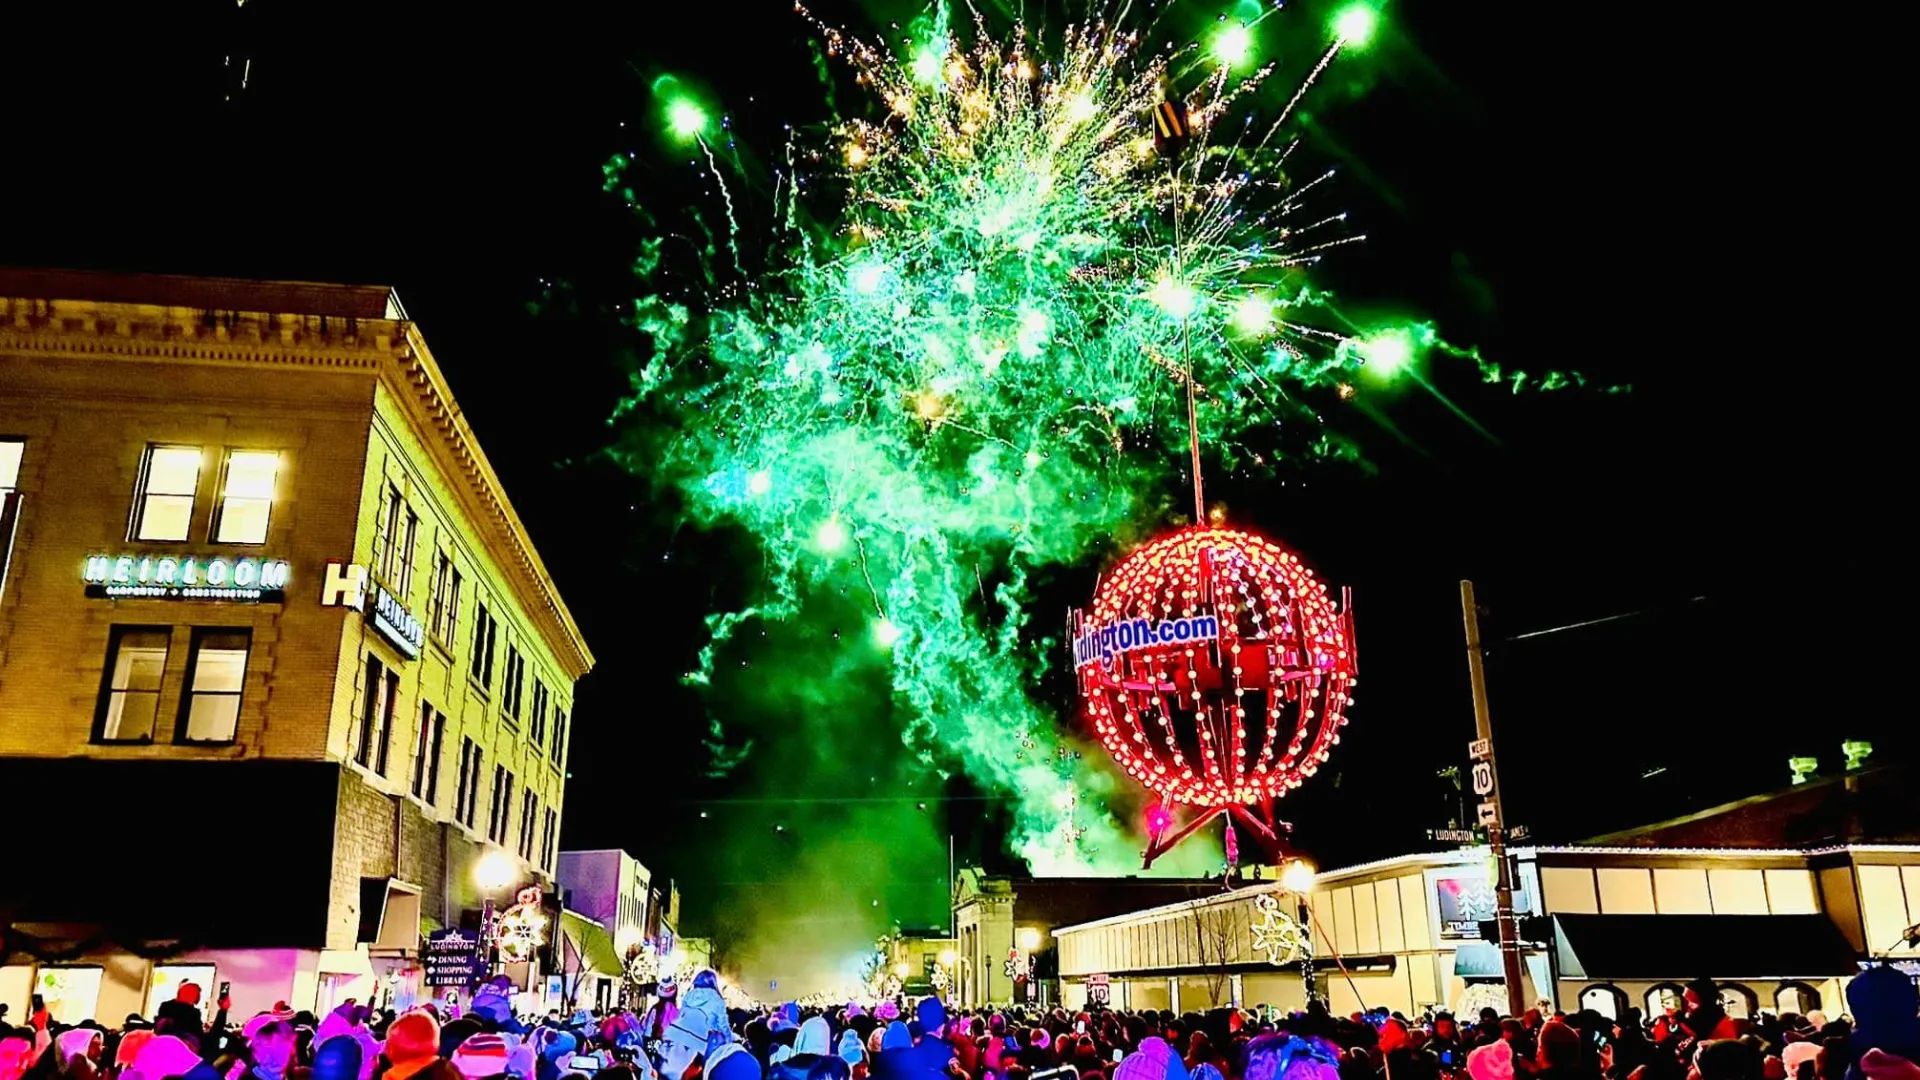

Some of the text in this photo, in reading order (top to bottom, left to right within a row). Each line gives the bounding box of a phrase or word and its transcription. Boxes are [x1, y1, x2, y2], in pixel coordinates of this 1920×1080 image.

[85, 556, 288, 588] HEIRLOOM
[105, 586, 167, 596] CARPENTRY
[182, 587, 261, 599] CONSTRUCTION
[1471, 741, 1486, 754] WEST
[1475, 768, 1489, 789] 10
[1435, 829, 1474, 841] LUDINGTON
[1448, 921, 1479, 931] TIMBE
[437, 966, 472, 974] SHOPPING
[436, 976, 467, 984] LIBRARY
[1095, 988, 1105, 1000] 10
